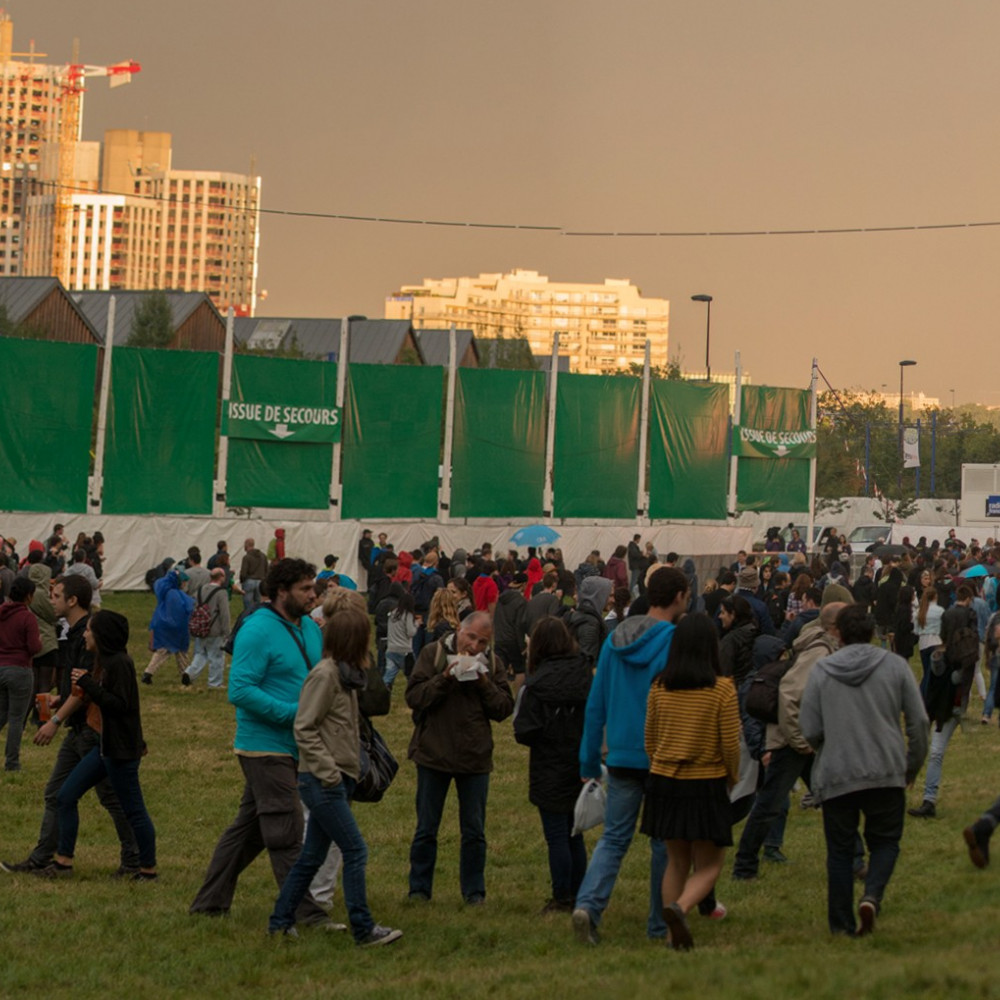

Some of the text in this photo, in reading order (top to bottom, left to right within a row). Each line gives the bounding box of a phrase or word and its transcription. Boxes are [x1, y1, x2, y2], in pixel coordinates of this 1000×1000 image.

[228, 402, 338, 425] ISSUE DE SECOURS
